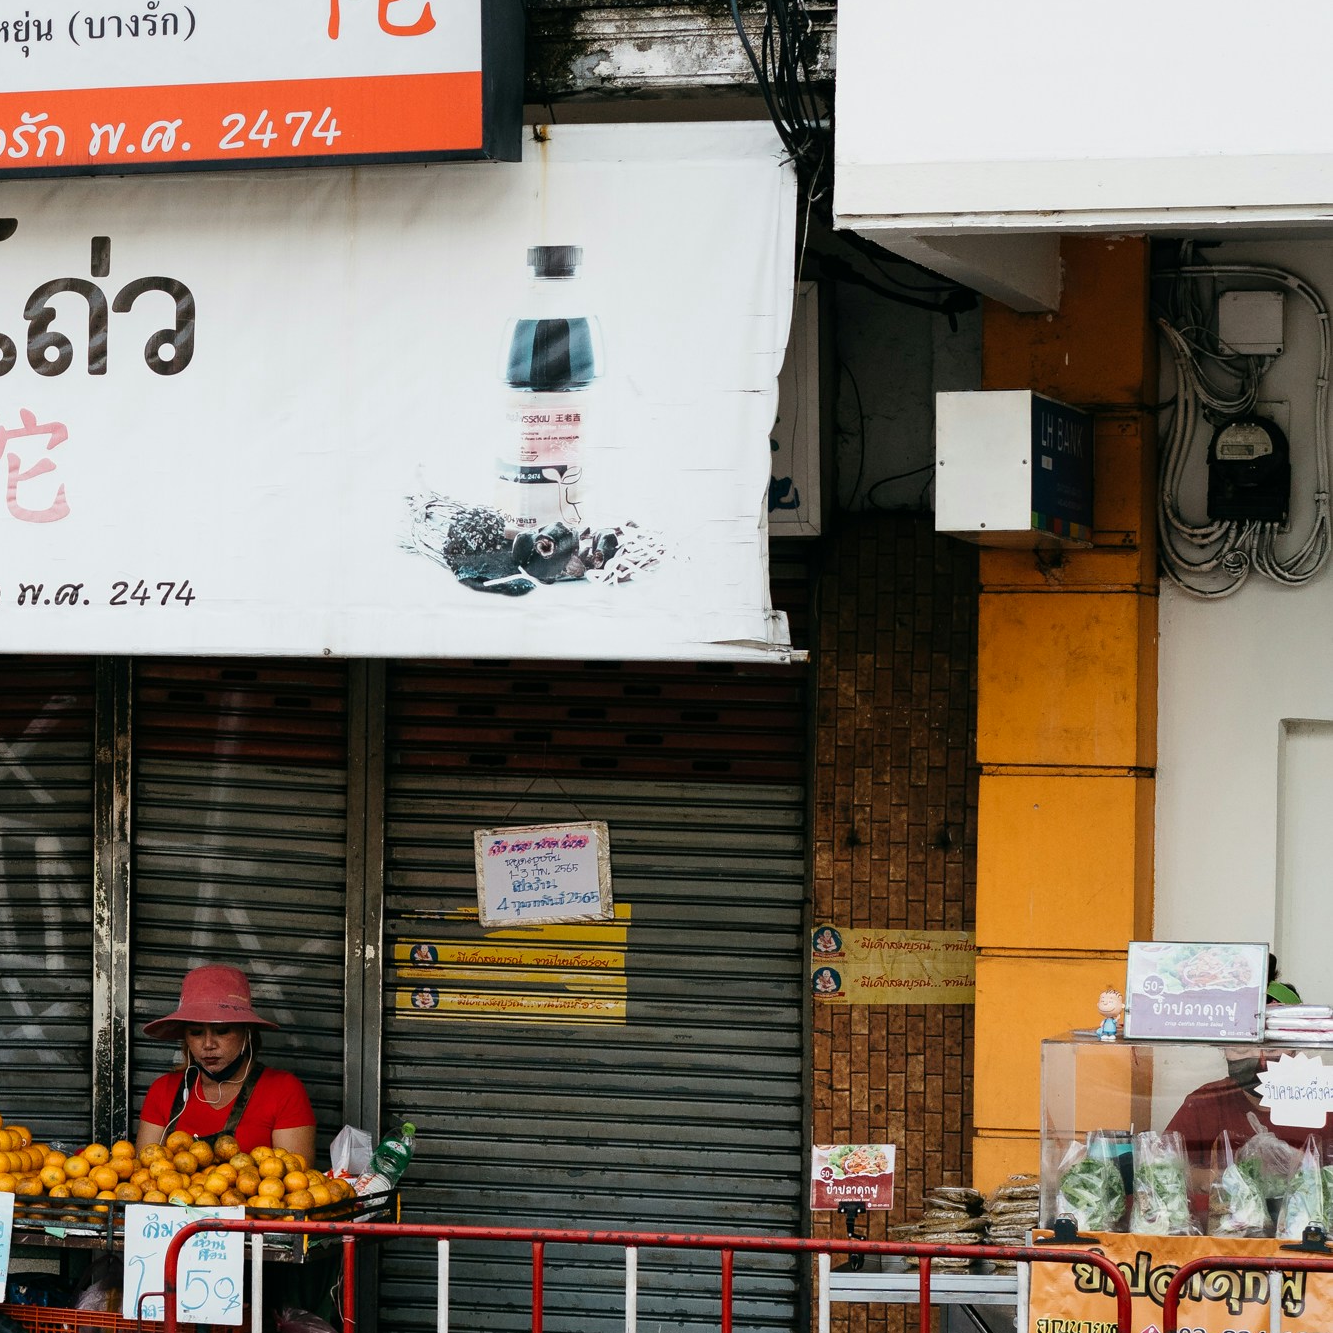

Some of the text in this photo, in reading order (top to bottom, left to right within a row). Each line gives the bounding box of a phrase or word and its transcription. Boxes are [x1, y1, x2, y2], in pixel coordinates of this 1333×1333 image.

[68, 0, 197, 47] (บางรัก)
[89, 121, 192, 155] พ.ศ.
[217, 106, 343, 151] 2474
[1041, 412, 1083, 459] LH BANK
[17, 581, 90, 606] พ.ศ.
[109, 579, 197, 606] 2474
[554, 863, 579, 874] 2565
[496, 897, 509, 910] 4
[566, 891, 600, 905] 2565
[1153, 997, 1237, 1022] ยำปลาดุกฟู
